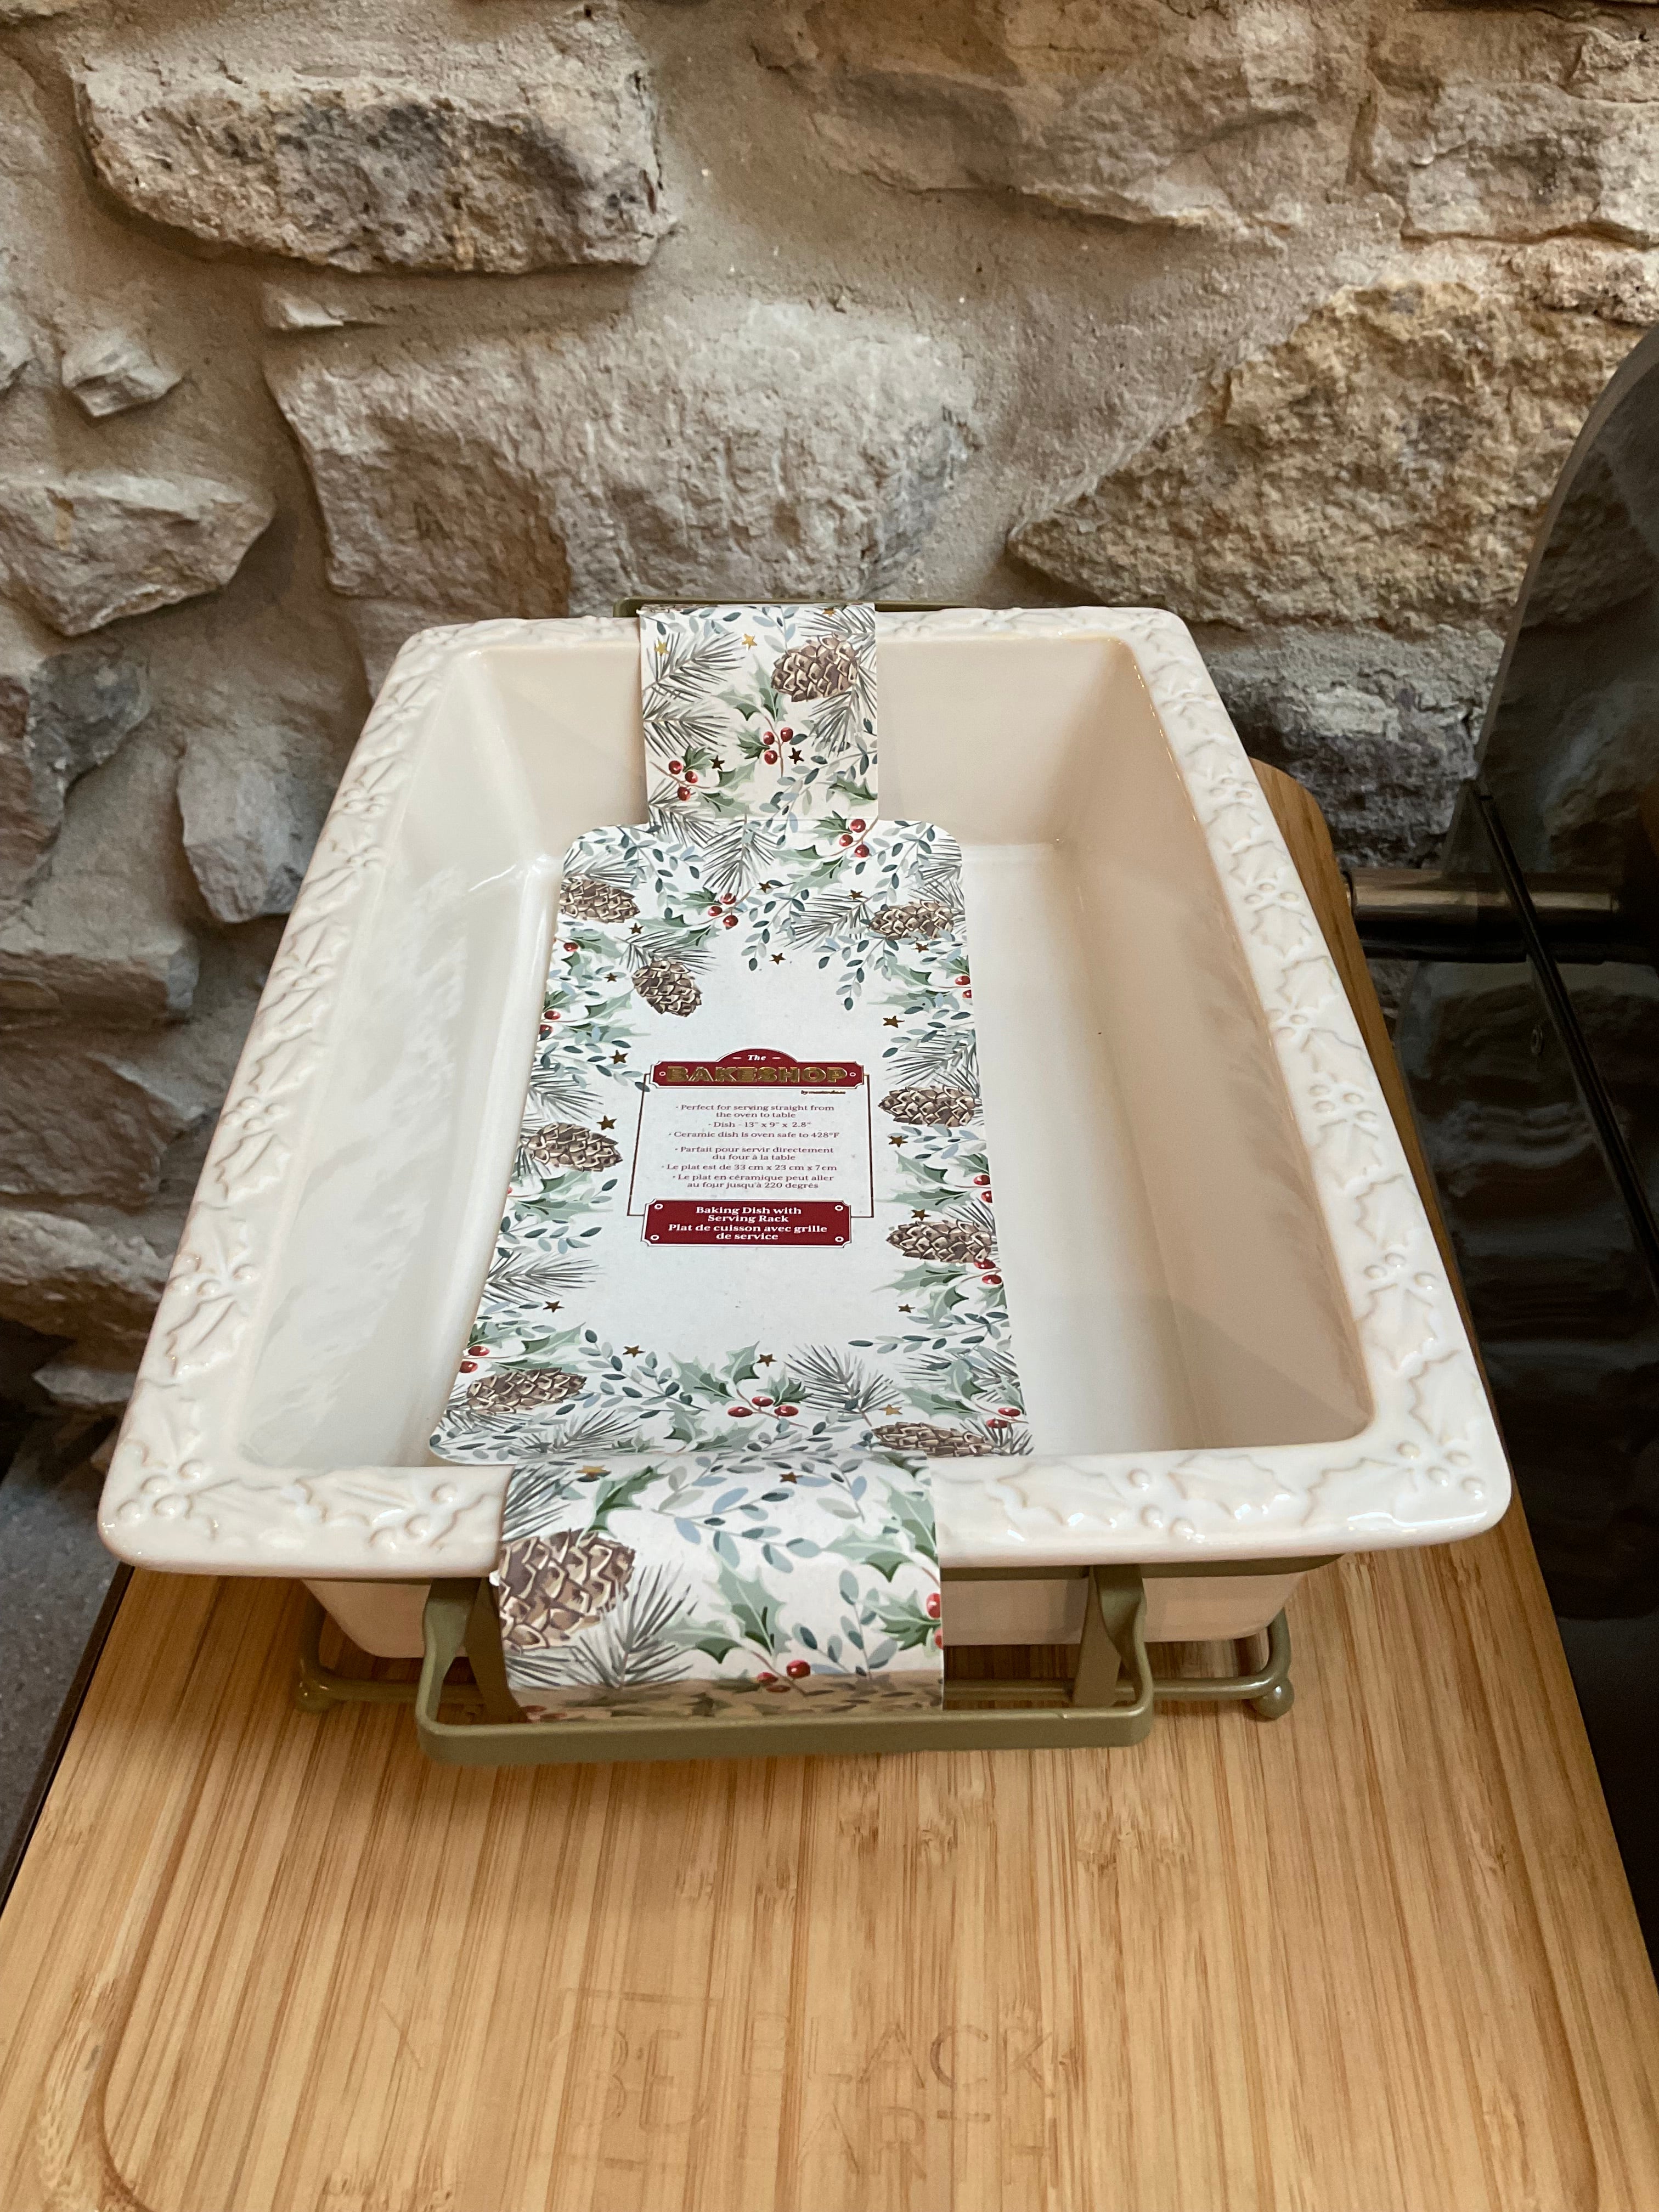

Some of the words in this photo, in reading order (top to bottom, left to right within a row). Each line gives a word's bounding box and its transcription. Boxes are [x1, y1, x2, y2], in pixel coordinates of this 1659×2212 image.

[667, 1066, 848, 1082] BAKESHOP
[696, 1206, 740, 1215] Baking
[708, 1215, 756, 1223] Serving
[794, 1225, 827, 1233] grille
